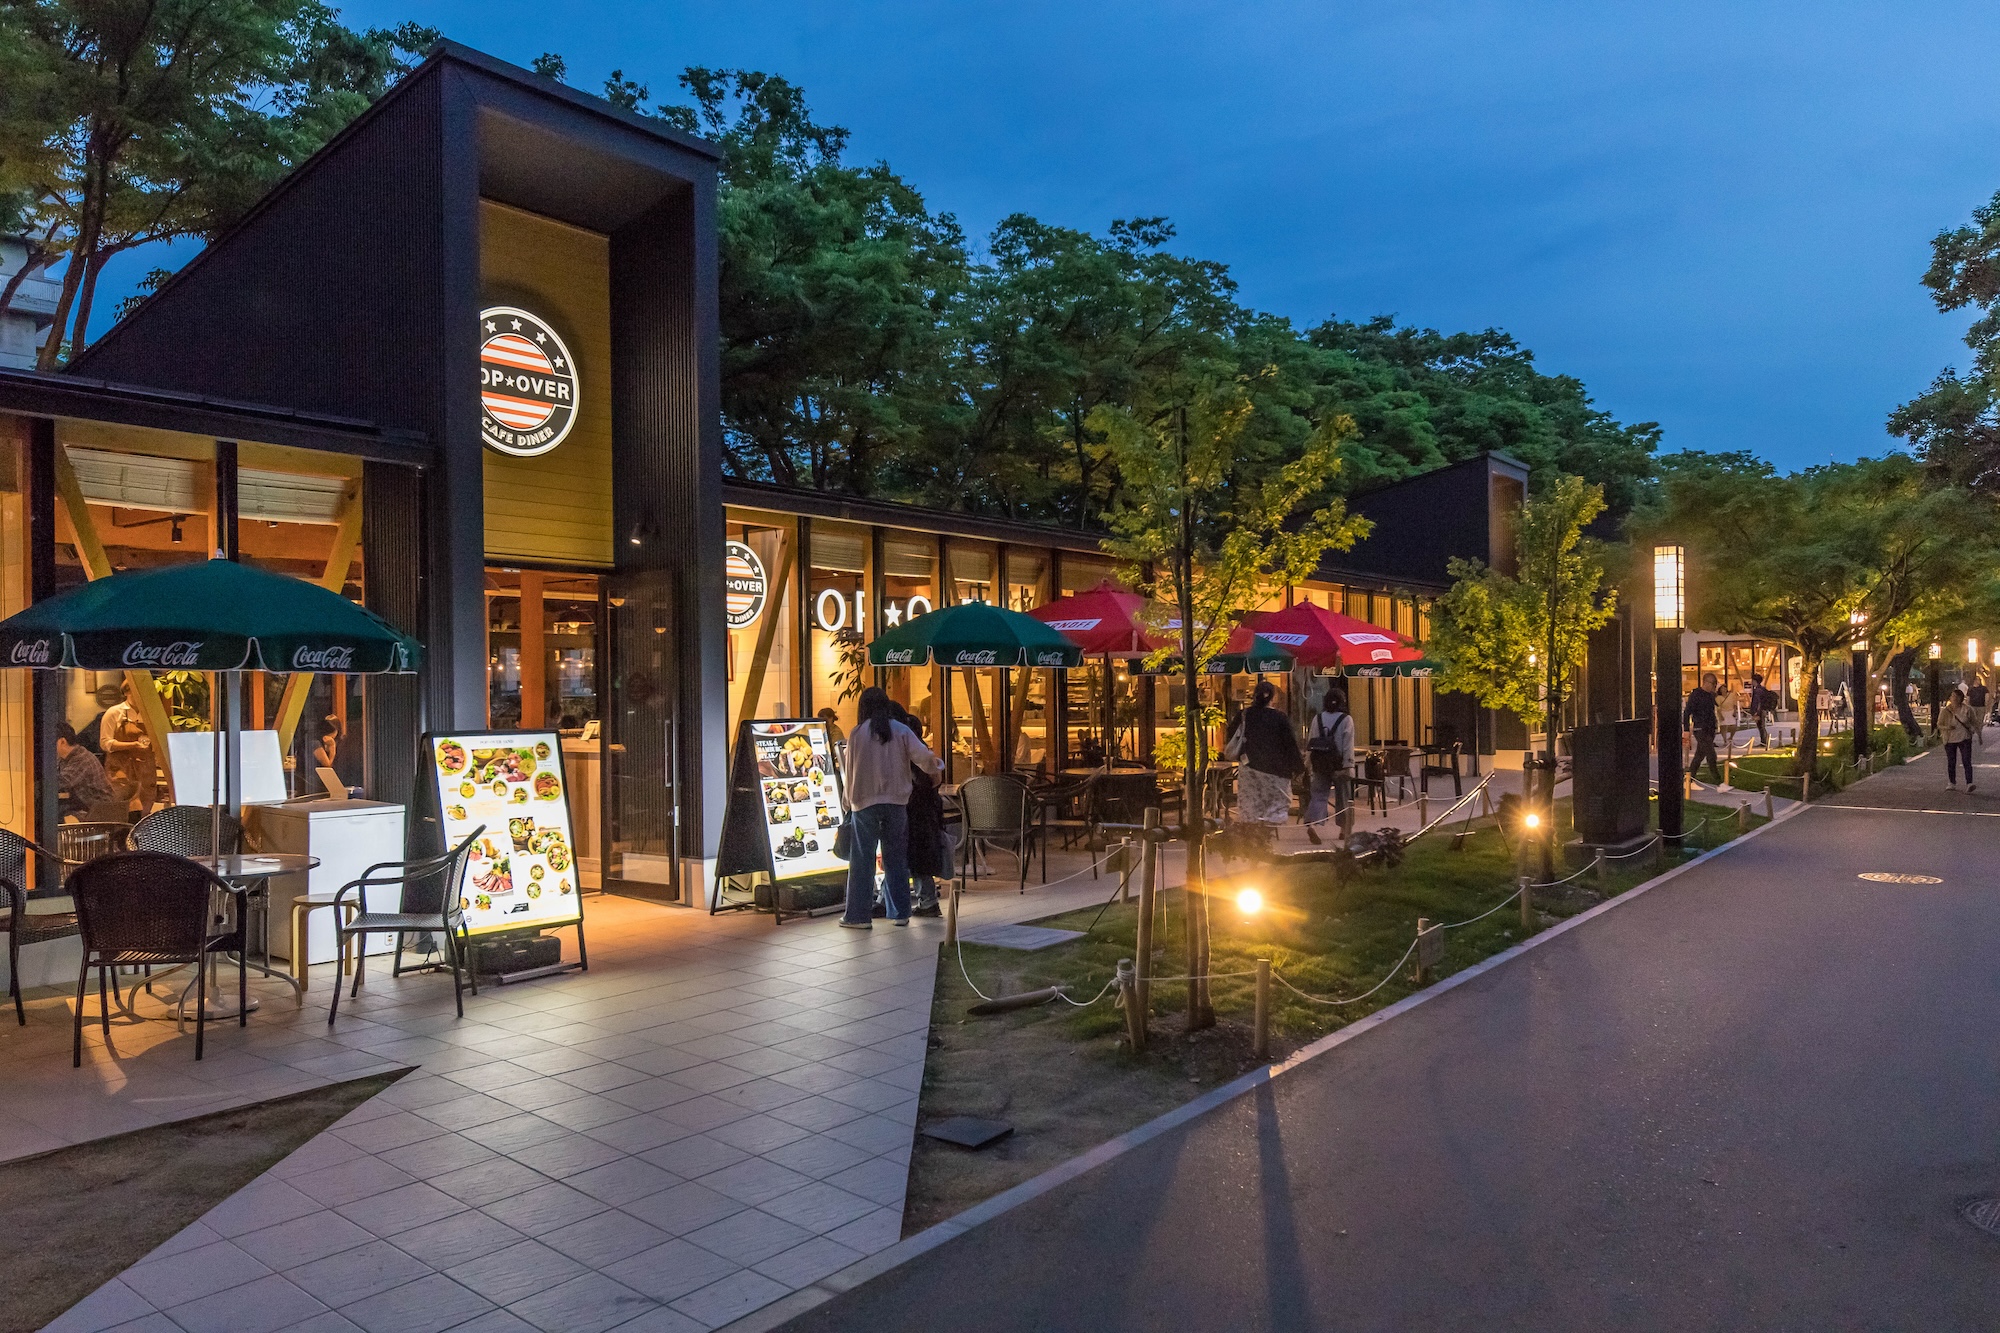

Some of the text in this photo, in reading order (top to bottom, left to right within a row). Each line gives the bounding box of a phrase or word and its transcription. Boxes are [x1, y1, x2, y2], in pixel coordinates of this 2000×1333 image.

[481, 367, 570, 400] OP OVER
[482, 416, 554, 446] CAFE DINER
[734, 579, 763, 593] OVER
[735, 608, 754, 623] DINER
[1047, 621, 1094, 629] RNOFF
[1261, 634, 1303, 643] RNOFF
[123, 641, 204, 666] Coca-Cola
[292, 645, 356, 669] Coca-Cola
[955, 650, 997, 664] Coca-Cola
